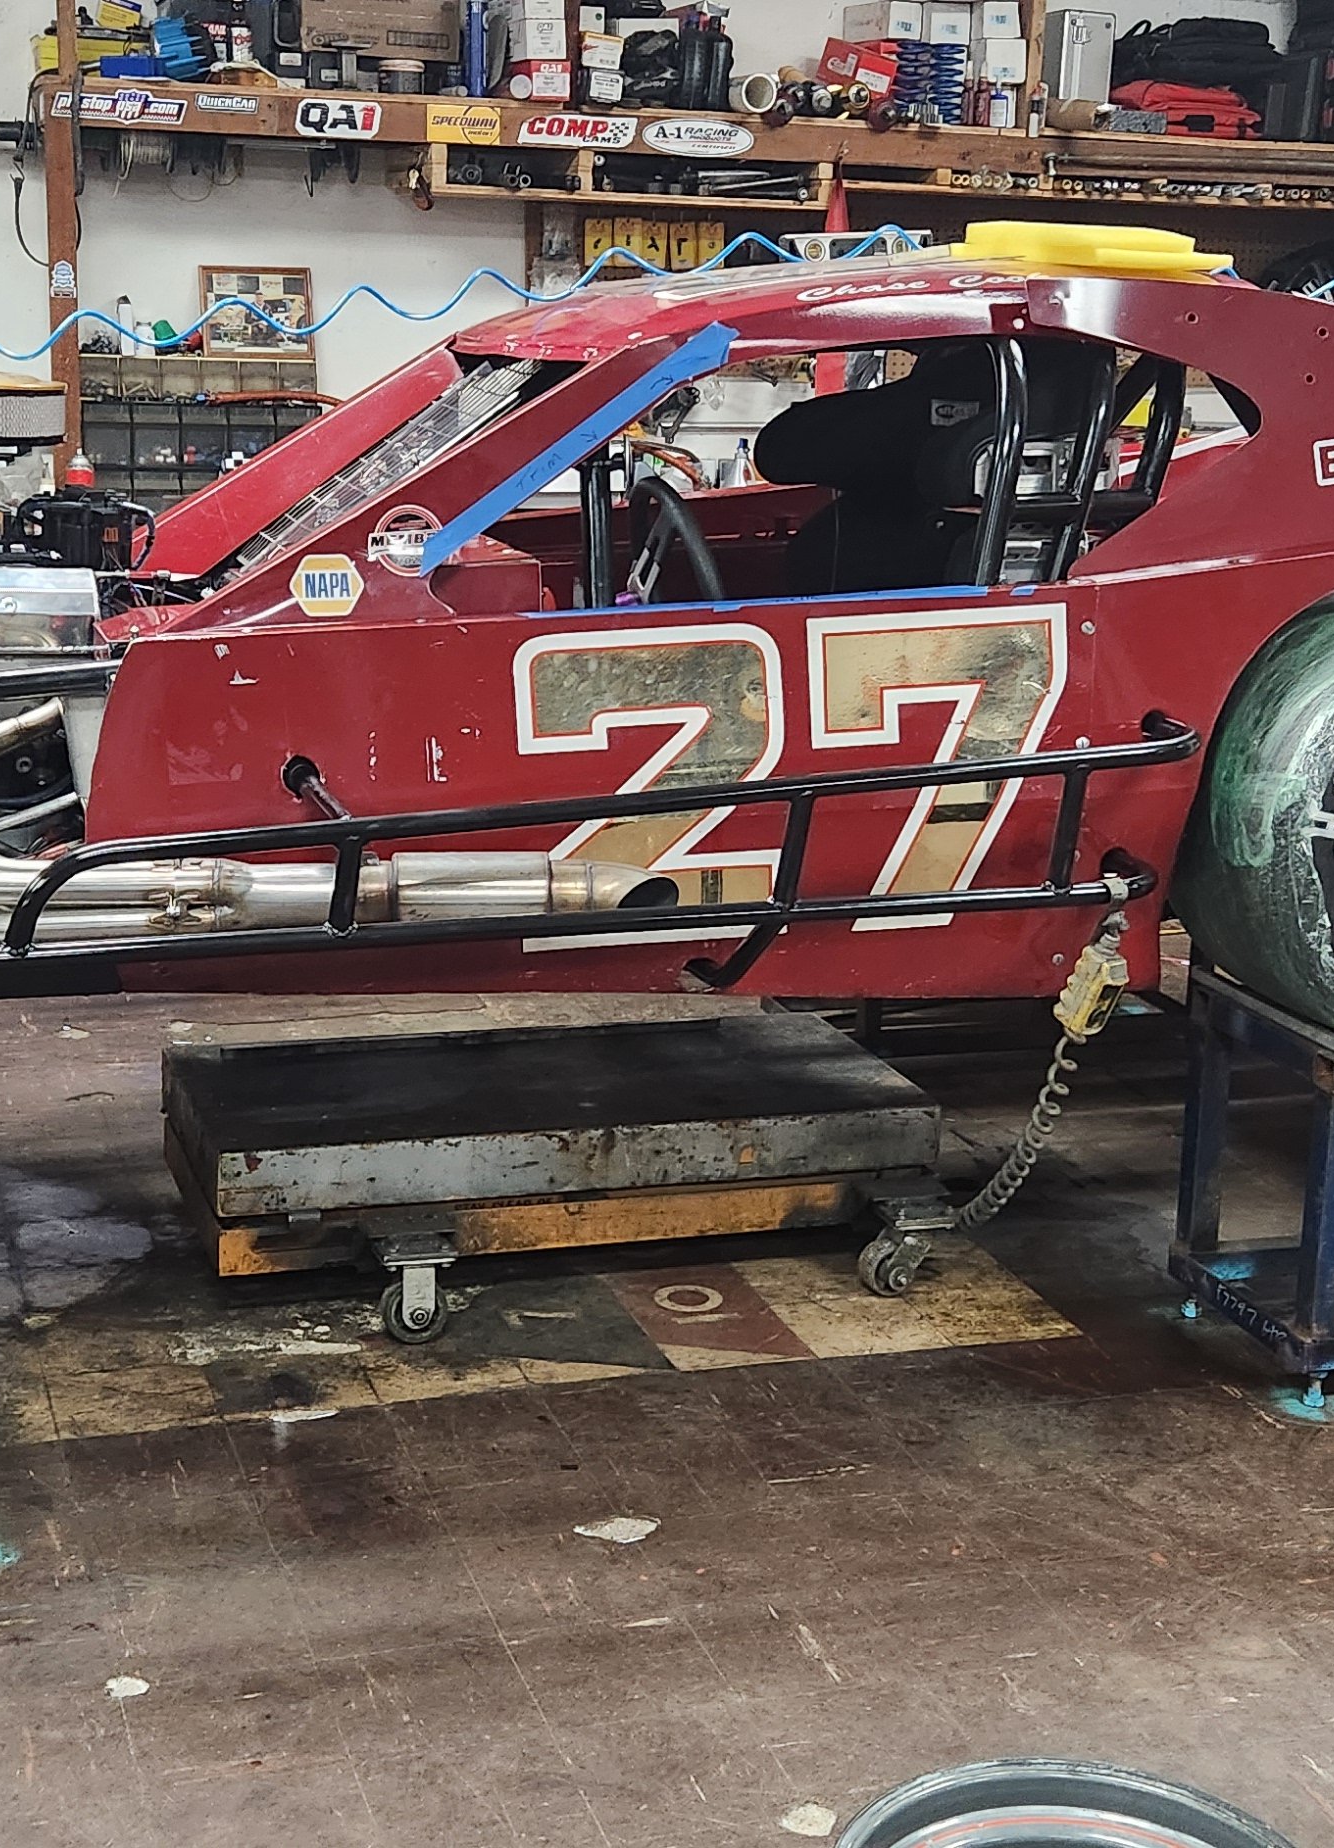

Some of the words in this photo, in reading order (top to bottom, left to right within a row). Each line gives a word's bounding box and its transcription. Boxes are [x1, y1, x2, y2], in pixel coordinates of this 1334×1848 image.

[80, 97, 112, 112] stop
[299, 102, 377, 133] QA1
[431, 115, 499, 130] SPEEDWAY
[527, 116, 610, 138] COMP
[581, 134, 622, 145] CAMS
[653, 125, 684, 141] A-1
[683, 127, 740, 138] RACING
[796, 280, 932, 302] Chase
[948, 273, 1029, 289] Coo
[304, 572, 351, 599] NAPA
[513, 602, 1068, 953] 27
